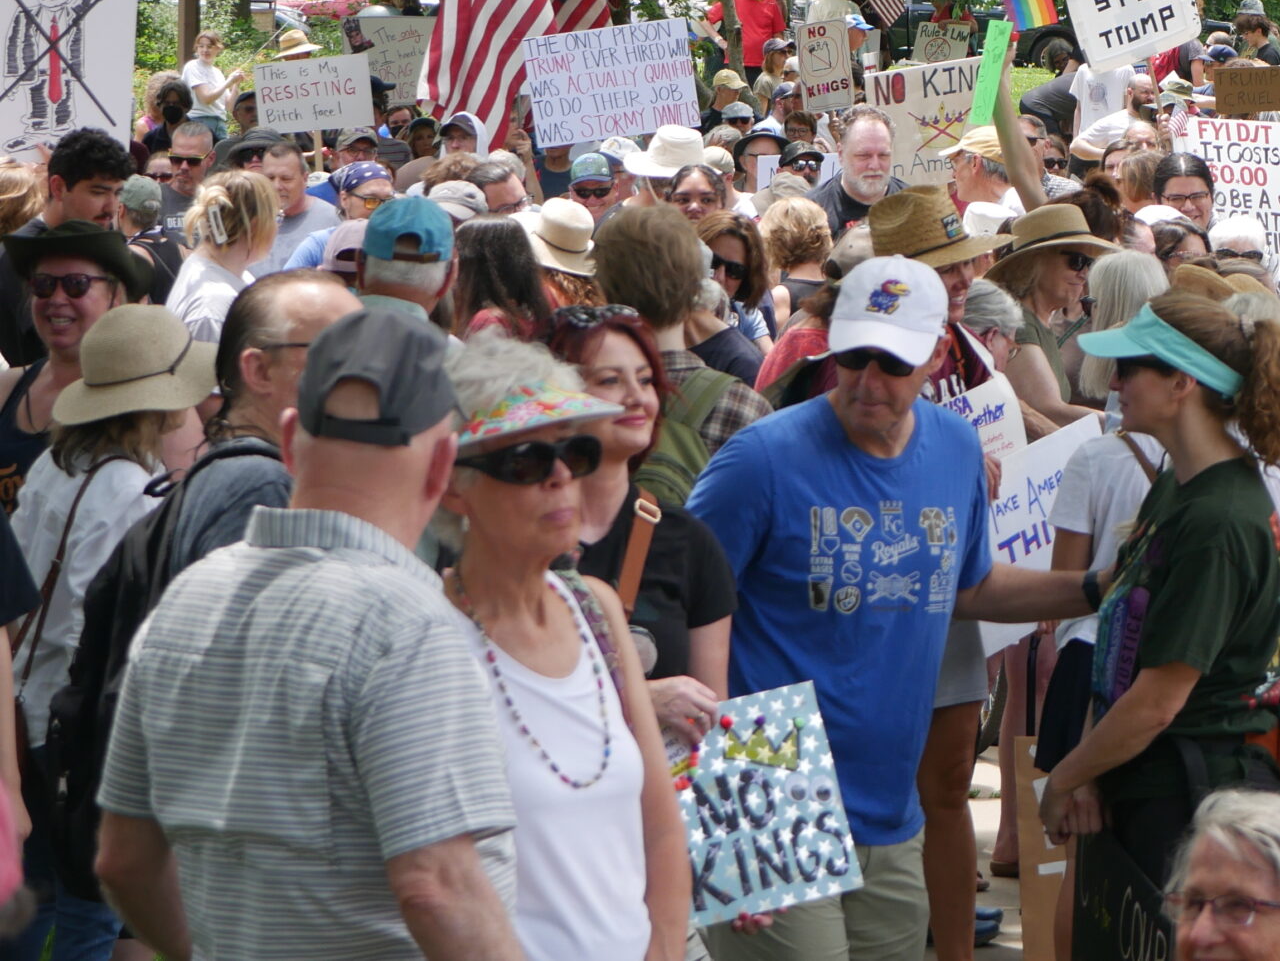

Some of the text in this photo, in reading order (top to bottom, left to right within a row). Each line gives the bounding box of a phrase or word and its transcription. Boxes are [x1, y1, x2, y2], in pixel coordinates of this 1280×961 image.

[373, 27, 396, 44] The
[807, 25, 827, 39] NO
[920, 25, 940, 38] Rule
[950, 28, 970, 43] LAW
[1098, 4, 1175, 48] TRUMP
[524, 21, 671, 57] THE ONLY PERSON
[257, 61, 339, 80] This is My
[526, 37, 690, 80] TRUMP EVER HIRED WHO
[530, 59, 693, 98] WAS ACTUALLY QUALIFIED
[807, 78, 849, 98] KINGS
[874, 65, 981, 106] NO KIN
[1216, 69, 1279, 86] TRUMP
[261, 78, 356, 104] RESISTING
[533, 83, 683, 120] TO DO THEIR JOB
[1224, 91, 1273, 108] CRUEL
[266, 101, 342, 124] Bitch face!
[536, 100, 700, 144] WAS STORMY DANIELS
[1198, 120, 1272, 144] FYI DJT
[1227, 142, 1280, 165] COSTS
[1230, 189, 1252, 208] BE
[1259, 189, 1271, 209] A
[1027, 469, 1063, 518] AMER
[883, 515, 903, 534] KC
[871, 533, 920, 566] Royals
[692, 768, 777, 840] NO
[689, 811, 850, 912] KINGS
